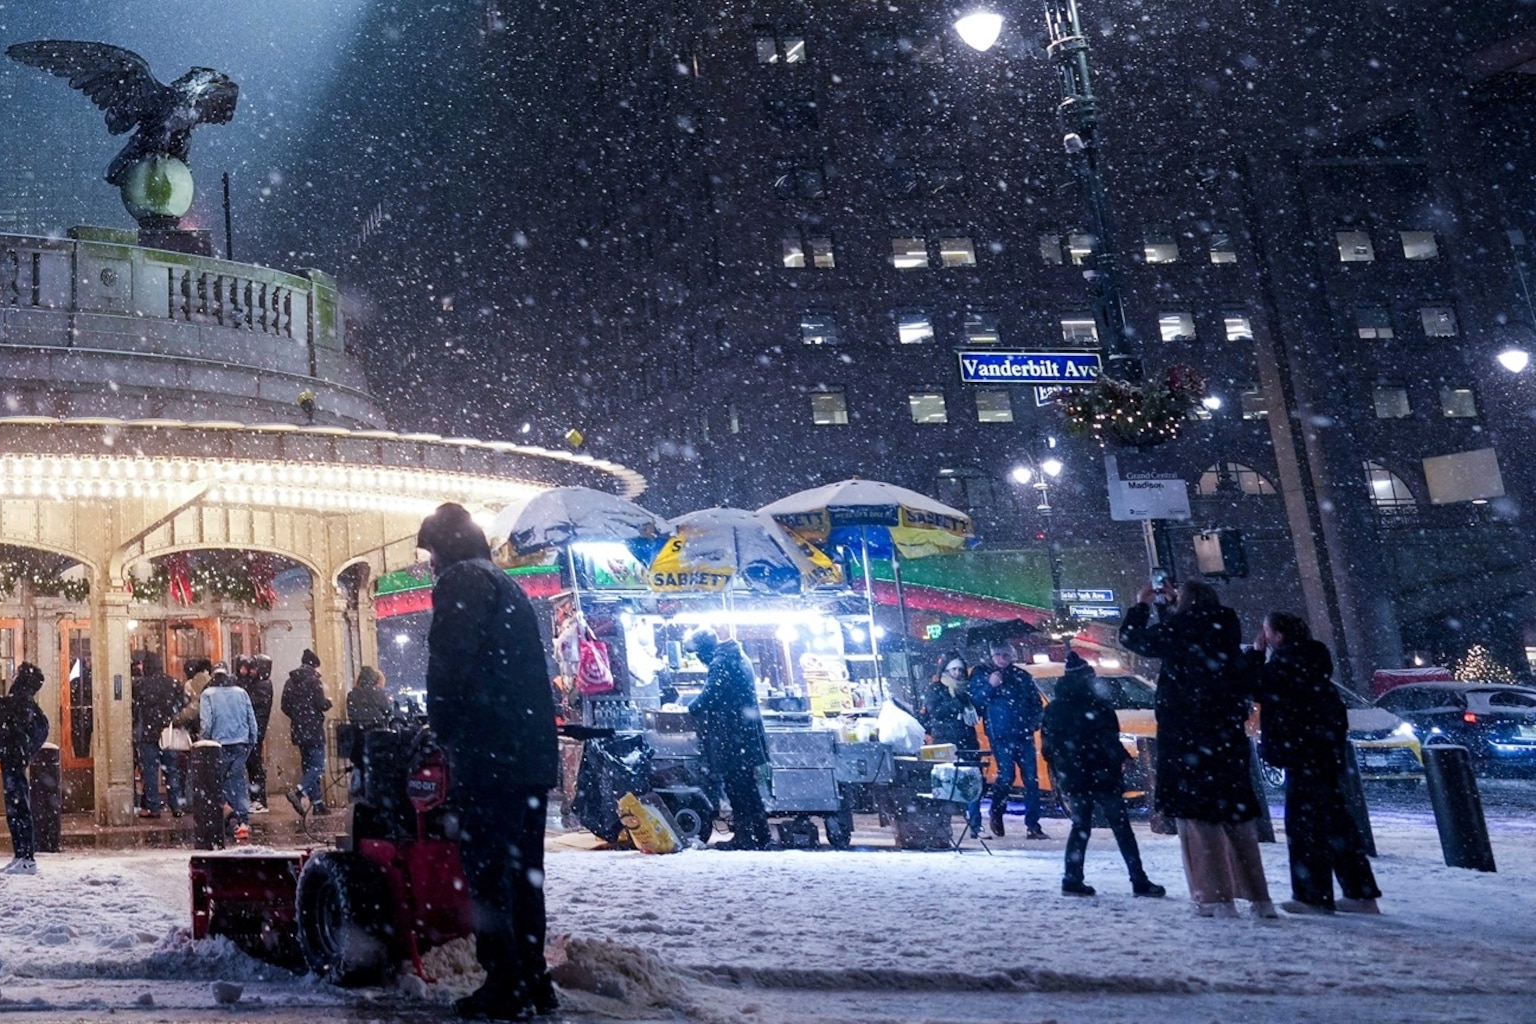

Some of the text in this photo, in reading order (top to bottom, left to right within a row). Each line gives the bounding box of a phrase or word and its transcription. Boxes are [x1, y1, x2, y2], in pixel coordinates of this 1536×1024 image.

[963, 359, 1060, 377] Vanderbilt
[1126, 471, 1178, 480] Grand Central
[1128, 481, 1165, 489] Madison
